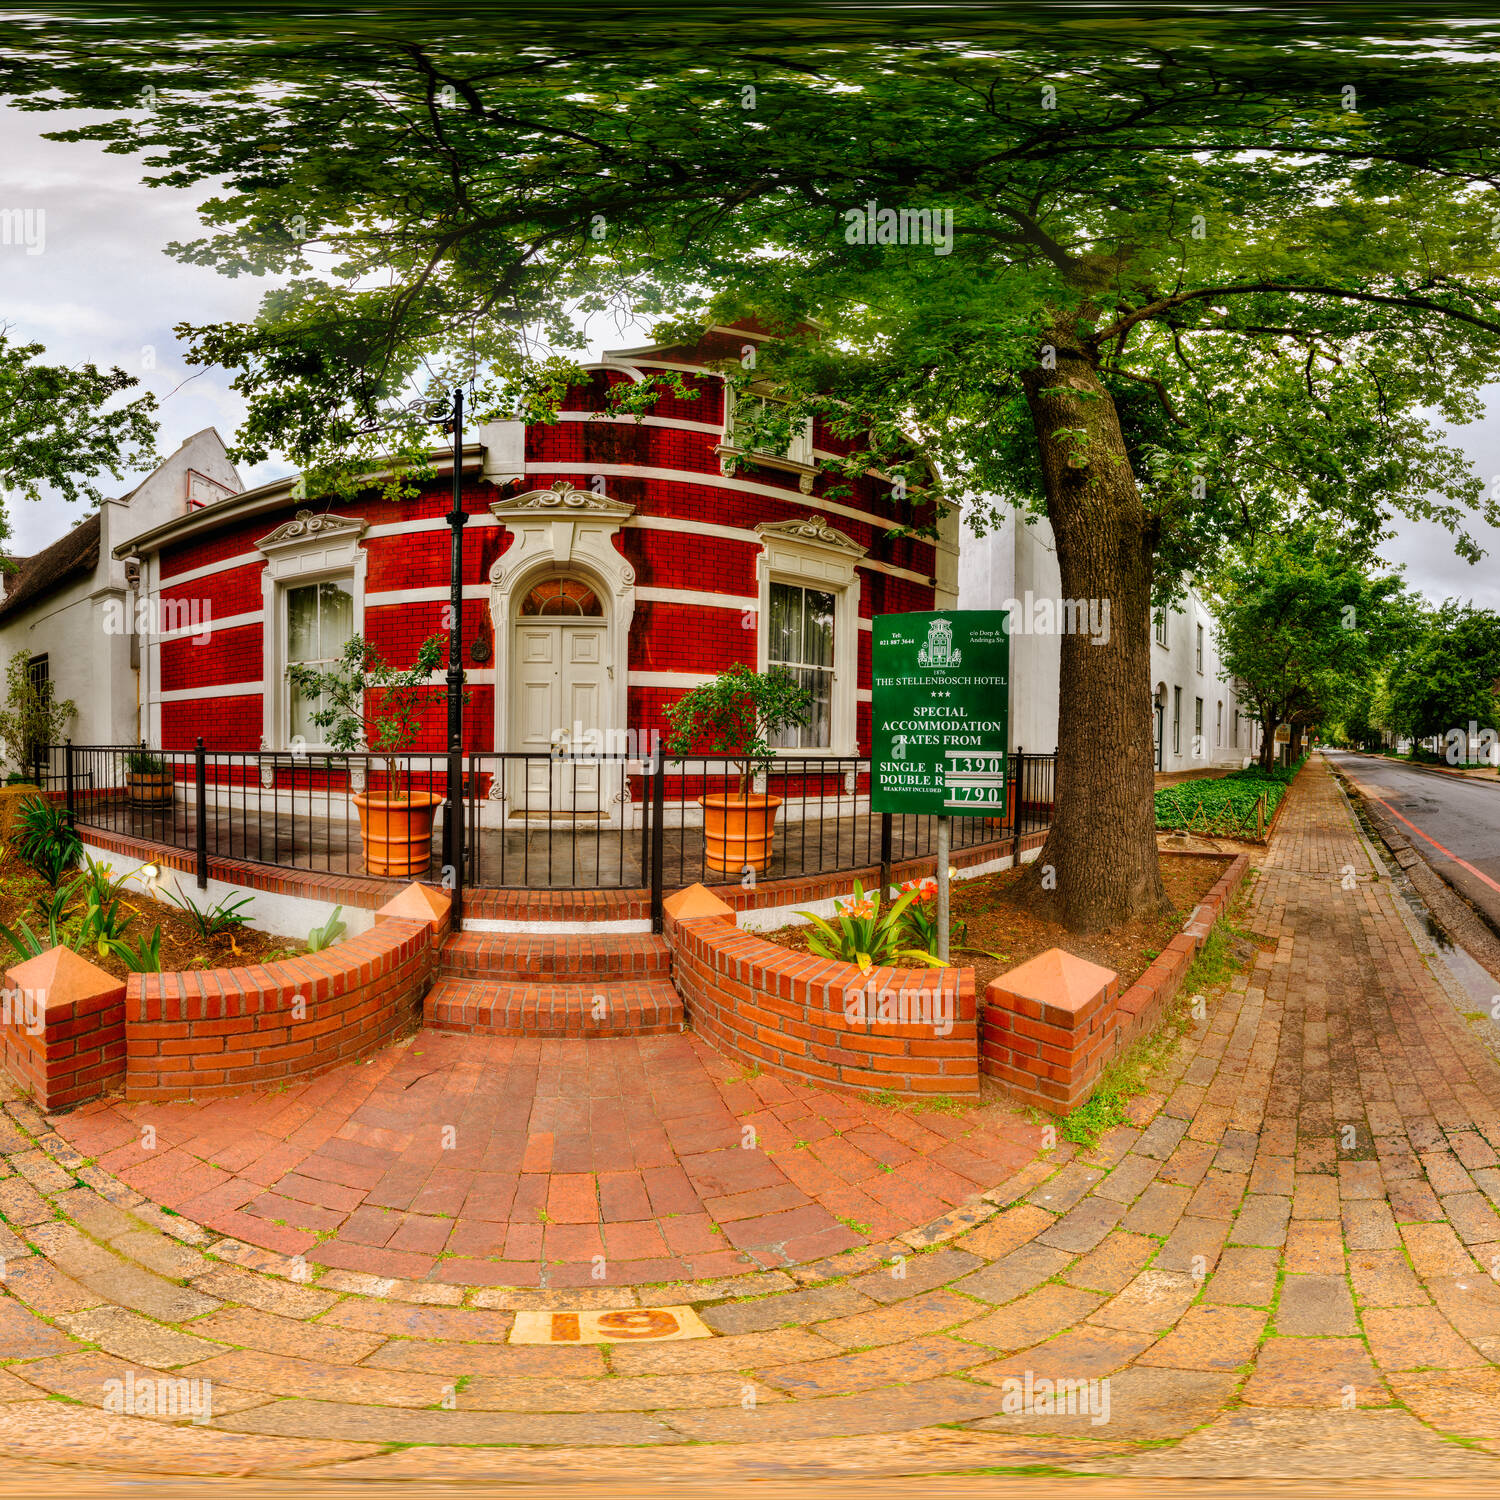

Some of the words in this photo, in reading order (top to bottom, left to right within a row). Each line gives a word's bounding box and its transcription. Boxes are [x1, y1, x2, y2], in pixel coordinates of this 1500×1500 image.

[875, 678, 894, 686] THE
[896, 676, 972, 686] STELLENBOSCH
[974, 676, 1008, 685] HOTEL
[913, 706, 968, 717] SPECIAL
[881, 720, 1001, 732] ACCOMMODATION
[899, 734, 940, 745] RATES
[943, 735, 982, 746] FROM
[879, 761, 926, 773] SINGLE
[935, 763, 944, 773] R
[951, 758, 999, 772] 1390
[880, 774, 931, 786] DOUBLE
[934, 775, 944, 786] R
[950, 787, 999, 802] 1790
[551, 1310, 681, 1342] 19
